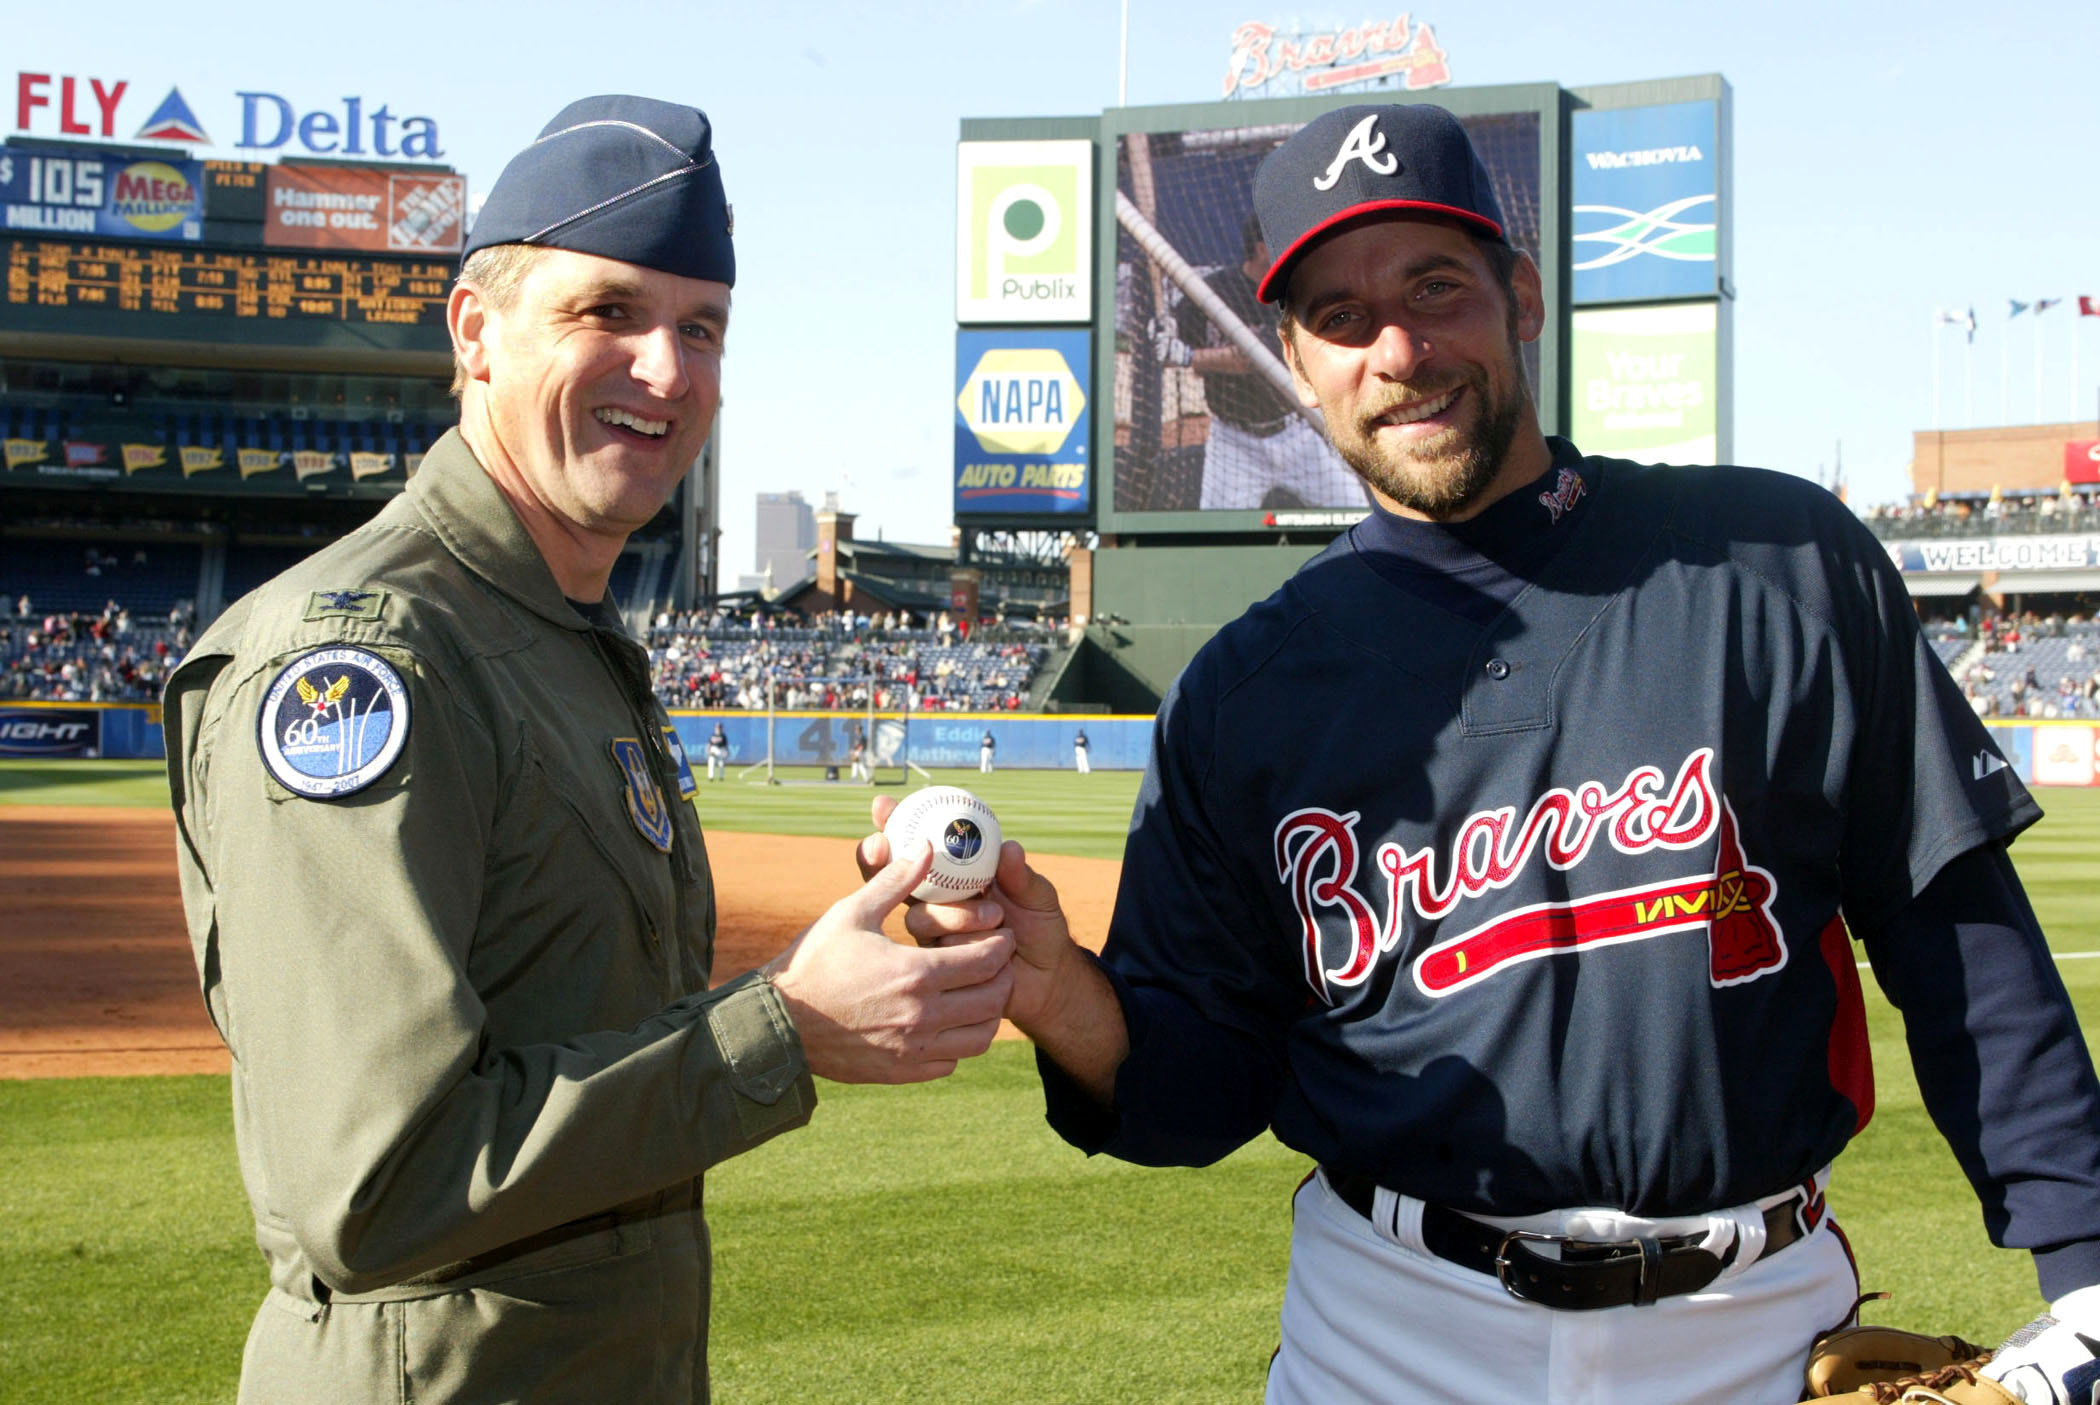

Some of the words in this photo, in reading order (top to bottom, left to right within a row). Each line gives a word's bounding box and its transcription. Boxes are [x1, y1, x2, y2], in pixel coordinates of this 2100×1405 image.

[1222, 13, 1411, 97] Braves
[17, 72, 128, 137] FLY
[234, 91, 446, 159] Delta
[1313, 114, 1398, 191] A
[1586, 146, 1703, 170] WACHOVIA
[0, 157, 13, 184] $
[30, 157, 104, 207] 105
[114, 172, 196, 201] MEGA
[273, 187, 382, 211] Hammer
[7, 205, 96, 232] MILLION
[281, 209, 327, 226] one
[329, 209, 379, 230] out.
[1002, 278, 1076, 300] Publix
[1605, 351, 1685, 382] Your
[981, 379, 1063, 424] NAPA
[1586, 378, 1703, 413] Braves
[958, 463, 1017, 489] AUTO
[1020, 463, 1087, 488] PARTS
[1925, 543, 2082, 567] WELCOME
[268, 663, 302, 702] UNITED
[303, 650, 348, 668] STATES
[371, 663, 402, 697] FORCE
[798, 718, 864, 764] 41
[900, 745, 981, 763] Mathew
[1274, 747, 1720, 1008] Braves
